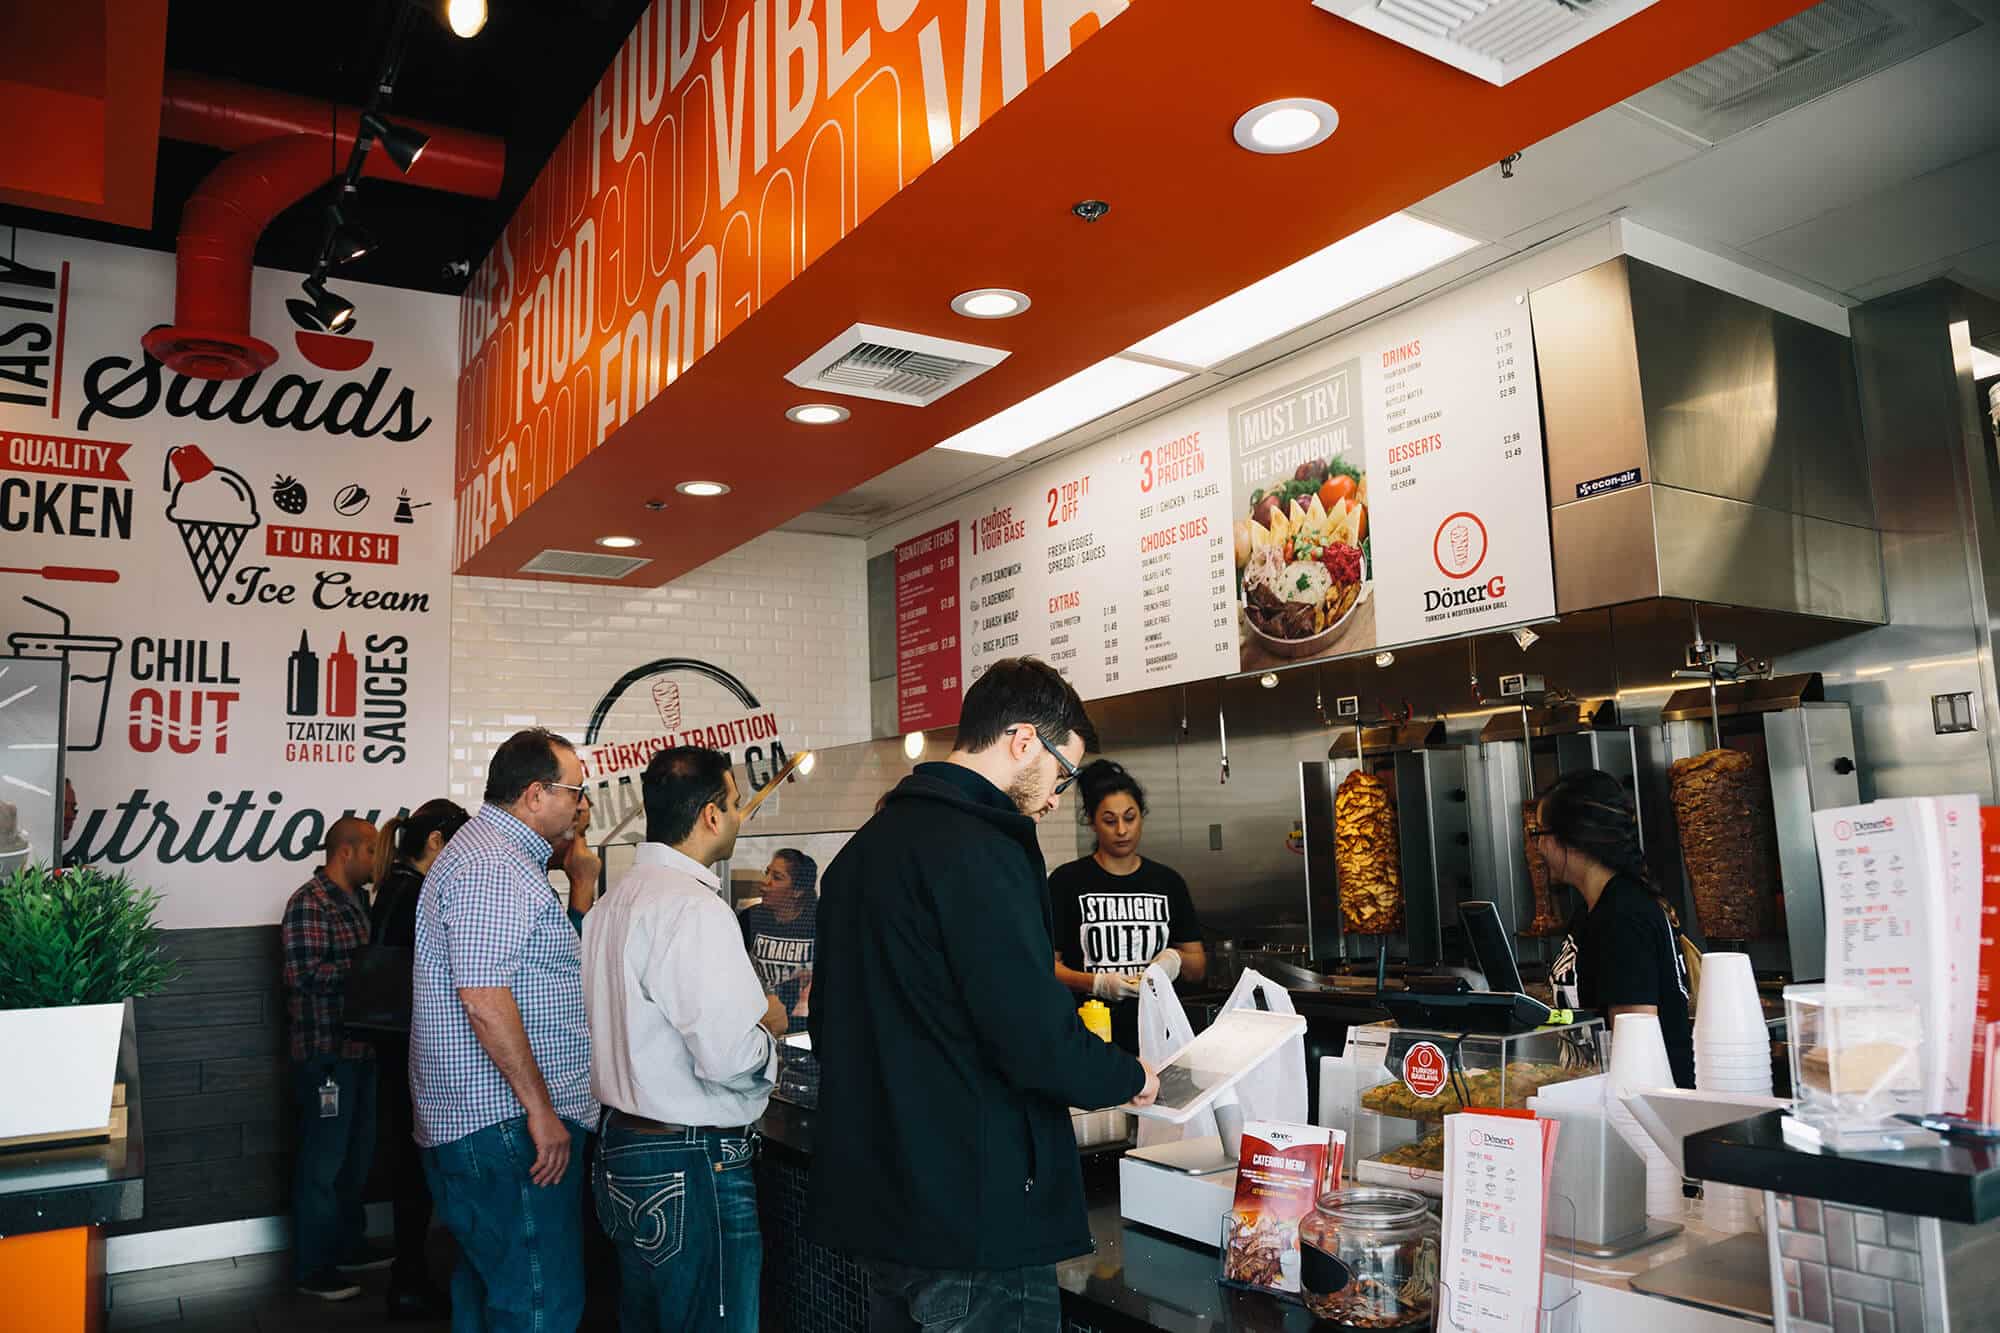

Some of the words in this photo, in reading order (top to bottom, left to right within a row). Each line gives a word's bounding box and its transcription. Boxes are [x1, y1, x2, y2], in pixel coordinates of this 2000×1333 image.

[516, 217, 595, 424] FOOD
[599, 74, 709, 334] GOOD
[1382, 340, 1420, 368] DRINKS
[1244, 398, 1296, 448] MUST
[1302, 381, 1340, 425] TRY
[1157, 431, 1200, 465] CHOOSE
[1388, 433, 1442, 464] DESSERTS
[1503, 432, 1520, 445] $2.99
[1504, 448, 1522, 460] $3.49
[9, 437, 112, 473] QUALITY
[1158, 450, 1205, 486] PROTEIN
[1241, 455, 1266, 485] THE
[1271, 426, 1352, 476] ISTANBOWL
[1140, 449, 1153, 493] 3
[1399, 478, 1416, 490] CREAM
[1591, 471, 1636, 490] econ-air
[1062, 480, 1078, 502] TOP
[1081, 475, 1090, 496] IT
[1160, 495, 1185, 512] CHICKEN
[1193, 483, 1220, 501] FALAFEL
[980, 507, 1012, 533] CHOOSE
[1047, 488, 1058, 528] 2
[1062, 500, 1078, 522] OFF
[273, 529, 391, 561] TURKISH
[970, 519, 977, 556] 1
[981, 529, 1001, 552] YOUR
[1004, 520, 1026, 544] BASE
[1048, 543, 1066, 559] FRESH
[1067, 533, 1093, 553] VEGGIES
[1140, 526, 1177, 553] CHOOSE
[1179, 516, 1209, 541] SIDES
[981, 571, 993, 585] PITA
[993, 563, 1022, 582] SANDWICH
[1048, 554, 1075, 575] SPREADS
[1081, 544, 1106, 563] SAUCES
[226, 565, 296, 606] Ice
[312, 570, 430, 613] Cream
[1049, 592, 1080, 614] EXTRAS
[1424, 576, 1506, 612] DönerG
[983, 639, 996, 654] RICE
[995, 633, 1019, 650] PLATTER
[130, 636, 240, 684] CHILL
[363, 633, 408, 765] SAUCES
[128, 687, 240, 754] OUT
[286, 722, 355, 742] TZATZIKI
[285, 743, 355, 763] GARLIC
[592, 734, 677, 776] TÜRKISH
[680, 712, 778, 749] TRADITION
[1086, 897, 1163, 922] STRAIGHT
[757, 939, 811, 962] STRAIGHT
[1252, 1153, 1284, 1169] CATERING
[1285, 1158, 1306, 1173] MENU
